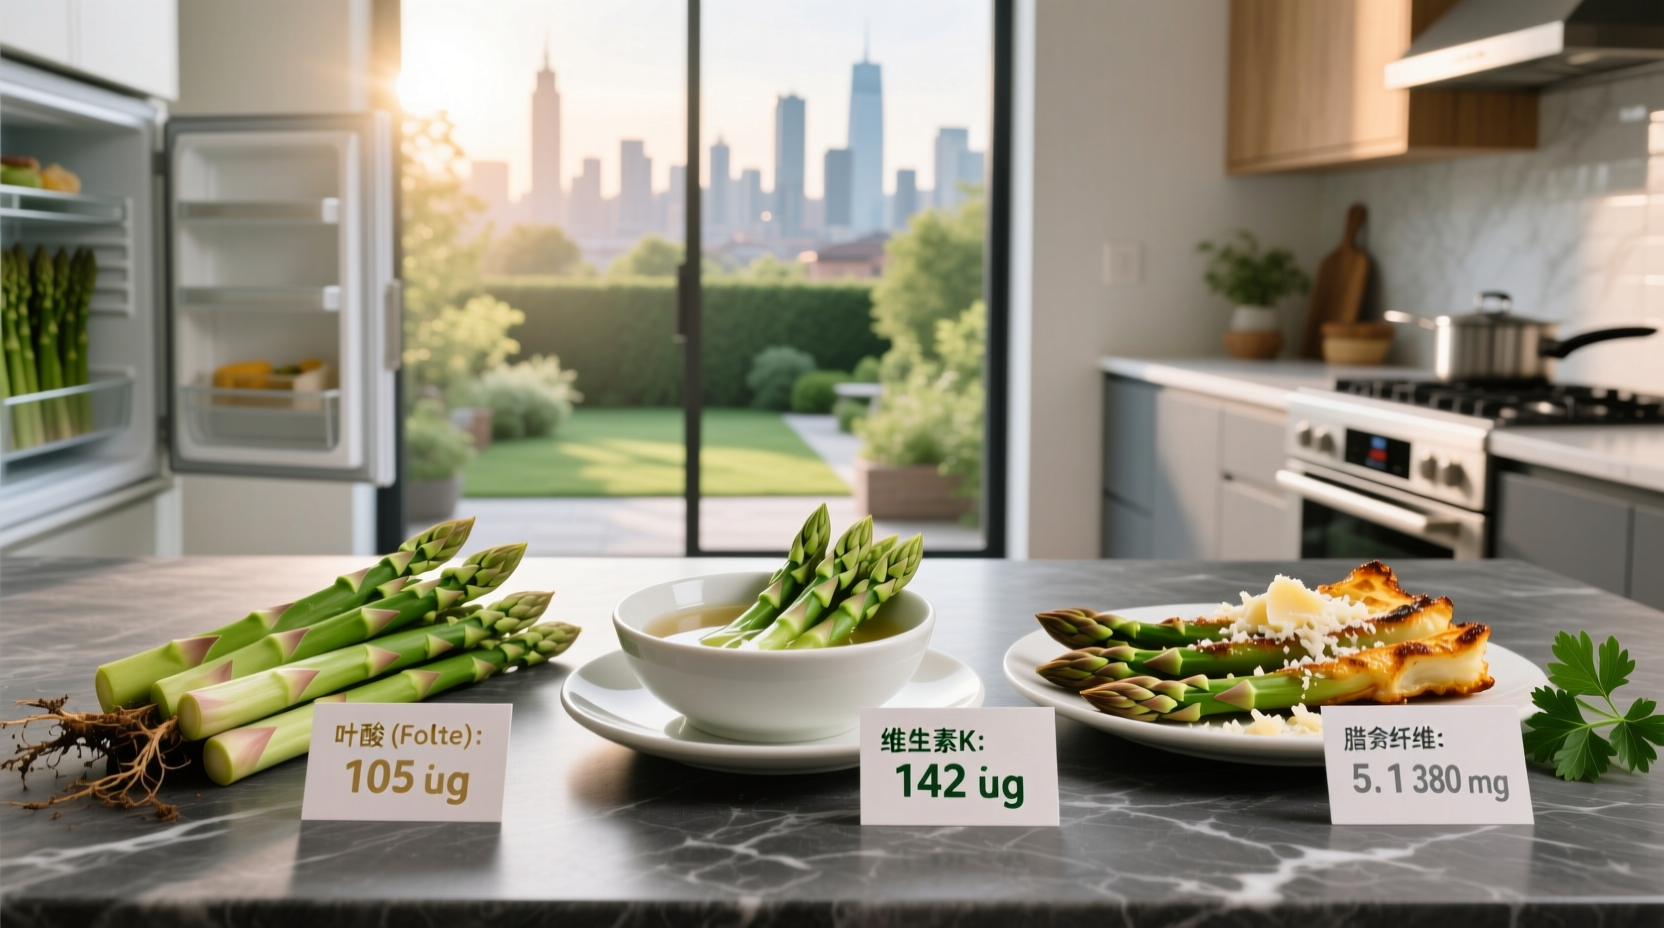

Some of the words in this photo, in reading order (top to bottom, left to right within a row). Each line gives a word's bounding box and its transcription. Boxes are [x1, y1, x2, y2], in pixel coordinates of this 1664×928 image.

[335, 722, 385, 747] 叶酸
[391, 723, 482, 749] (Folte):
[881, 727, 985, 753] 维生素K:
[346, 758, 415, 794] 105
[896, 763, 966, 798] 142
[1412, 764, 1462, 794] 380
[1468, 774, 1509, 802] mg
